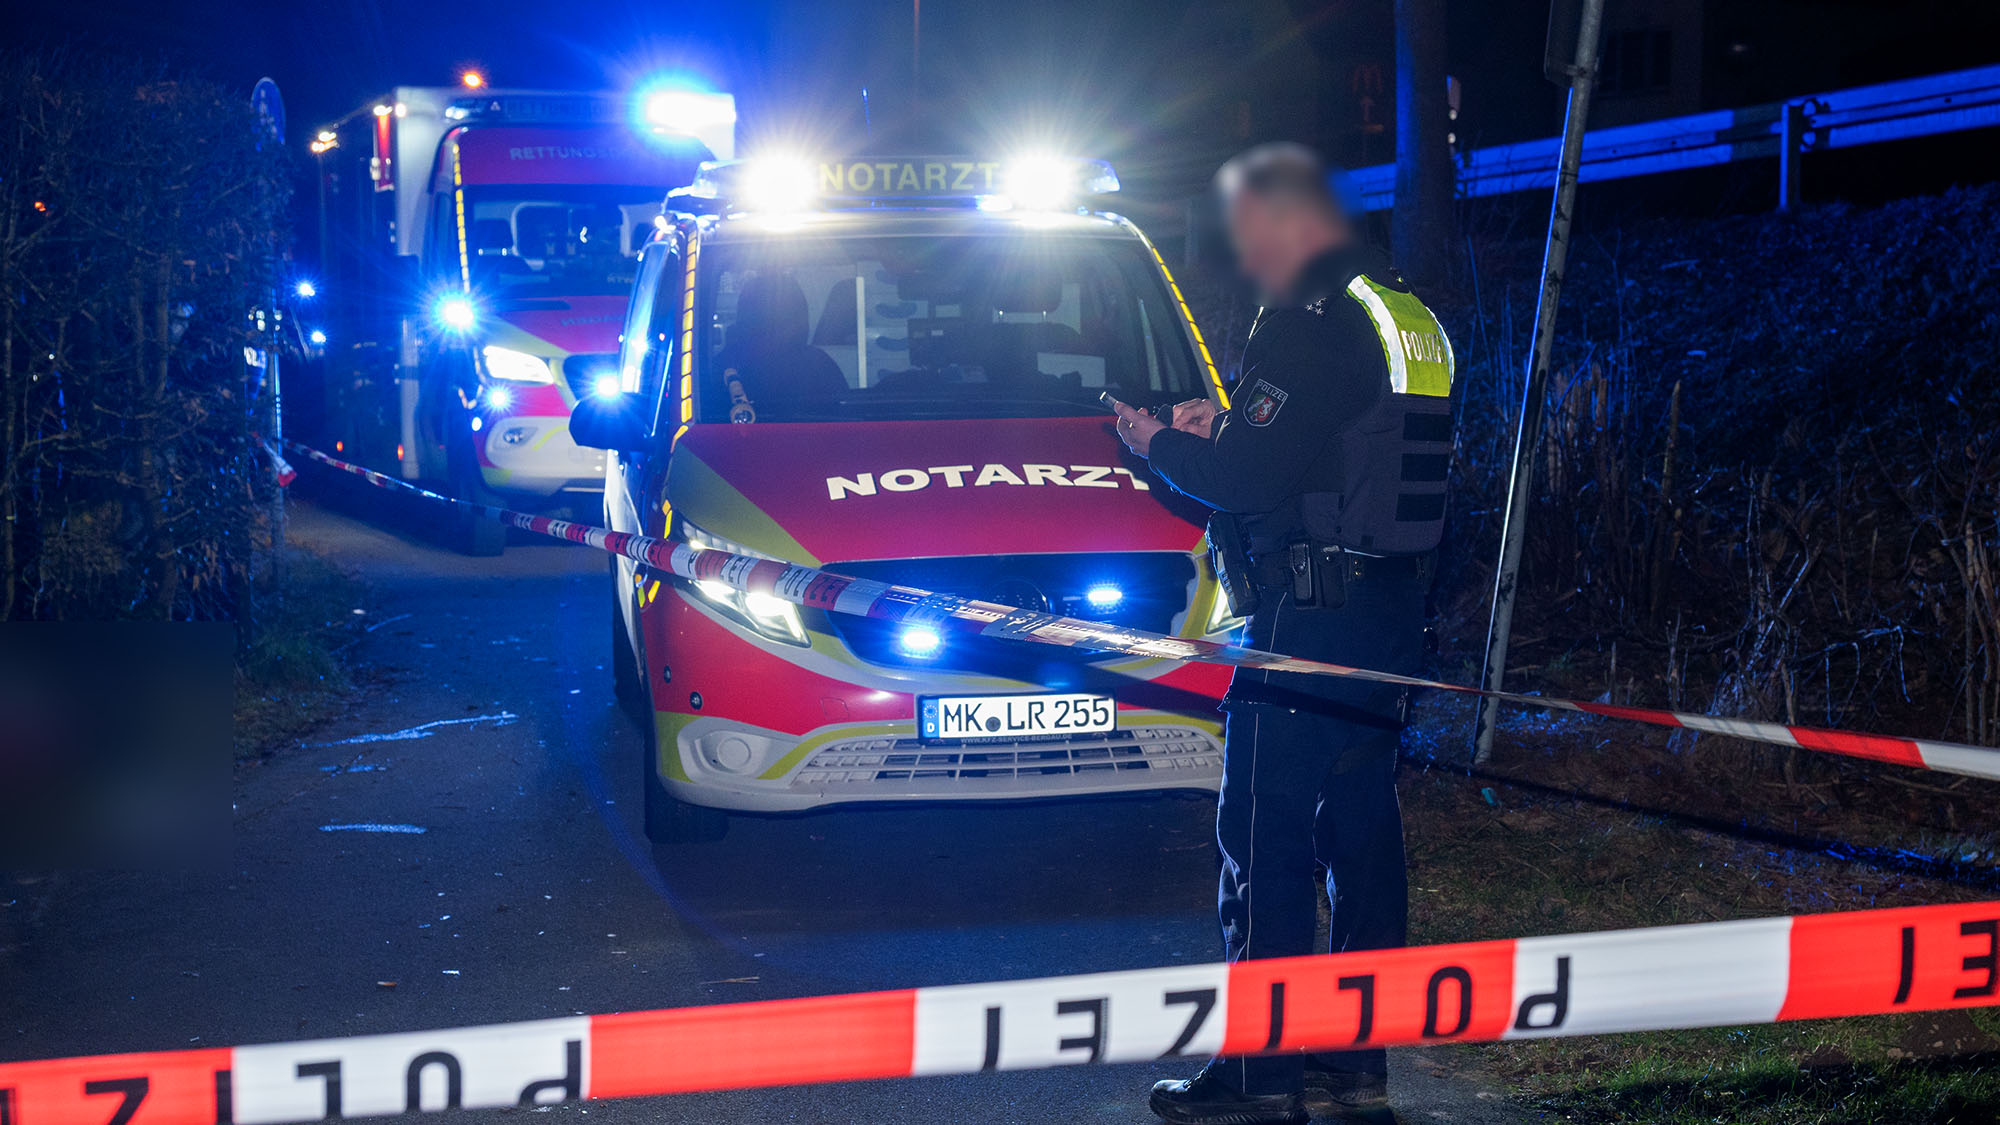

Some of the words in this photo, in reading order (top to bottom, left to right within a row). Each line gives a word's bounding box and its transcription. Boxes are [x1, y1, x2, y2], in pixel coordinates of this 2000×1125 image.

[818, 162, 1000, 192] NOTARZT
[1257, 380, 1288, 402] POLIZEI
[826, 463, 1150, 500] NOTARZT
[926, 721, 936, 734] D
[943, 703, 983, 732] MK
[1007, 701, 1046, 731] LR
[1054, 698, 1110, 729] 255
